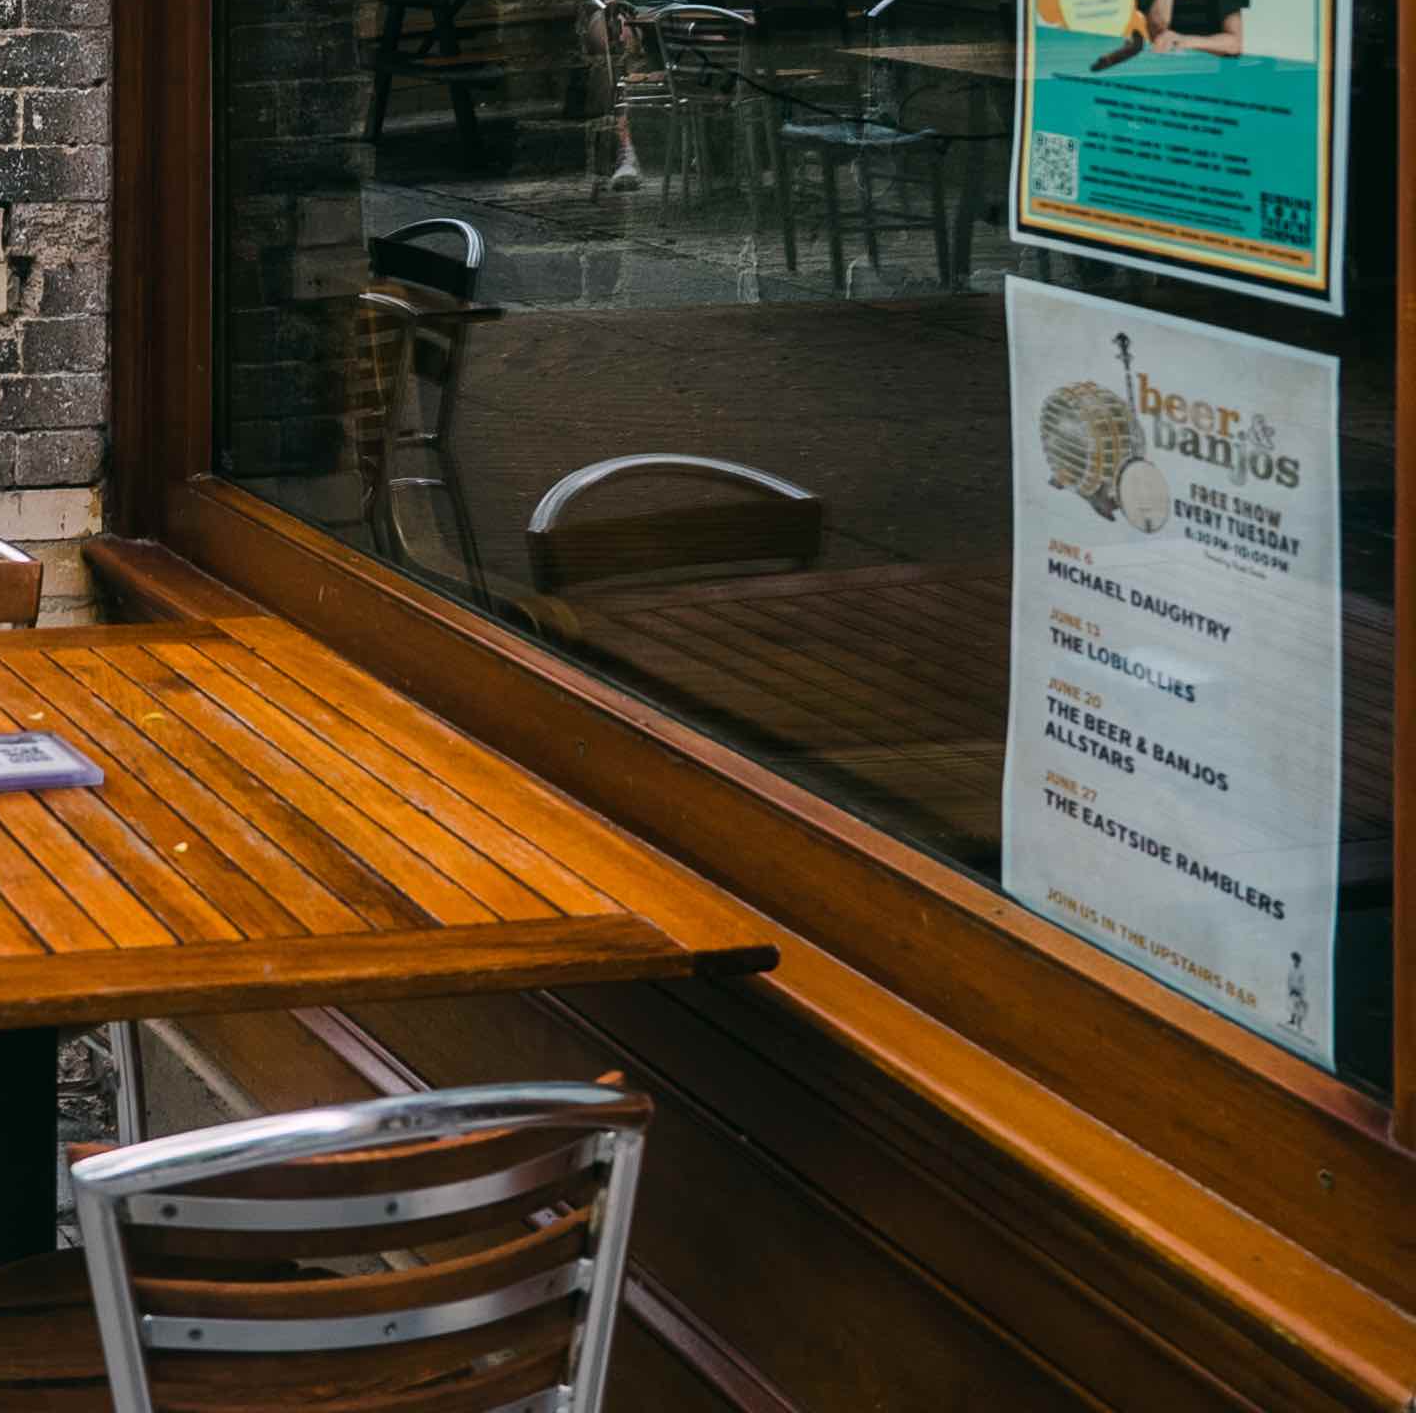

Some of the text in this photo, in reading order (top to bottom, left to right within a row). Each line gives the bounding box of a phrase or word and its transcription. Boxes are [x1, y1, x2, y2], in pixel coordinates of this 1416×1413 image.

[1136, 372, 1241, 438] beer
[1153, 411, 1301, 489] banjos
[1174, 498, 1301, 558] EVERY TUESDAY
[1190, 483, 1282, 528] FREE SHOW
[1047, 536, 1081, 561] JUNE
[1047, 558, 1231, 645] MICHAEL DAUGHTRY
[1049, 605, 1083, 632] JUNE
[1047, 676, 1103, 711] JUNE 20
[1049, 625, 1197, 705] THE LOBLOLLIES
[1043, 720, 1136, 776] ALLSTARS
[1046, 695, 1230, 793] THE BEER & BANJOS
[1045, 768, 1098, 804] JUNE 27
[1043, 787, 1287, 922] THE EASTSIDE RAMBLERS
[1047, 885, 1260, 1010] JOIN US IN THE UPSTAIRS BAR
